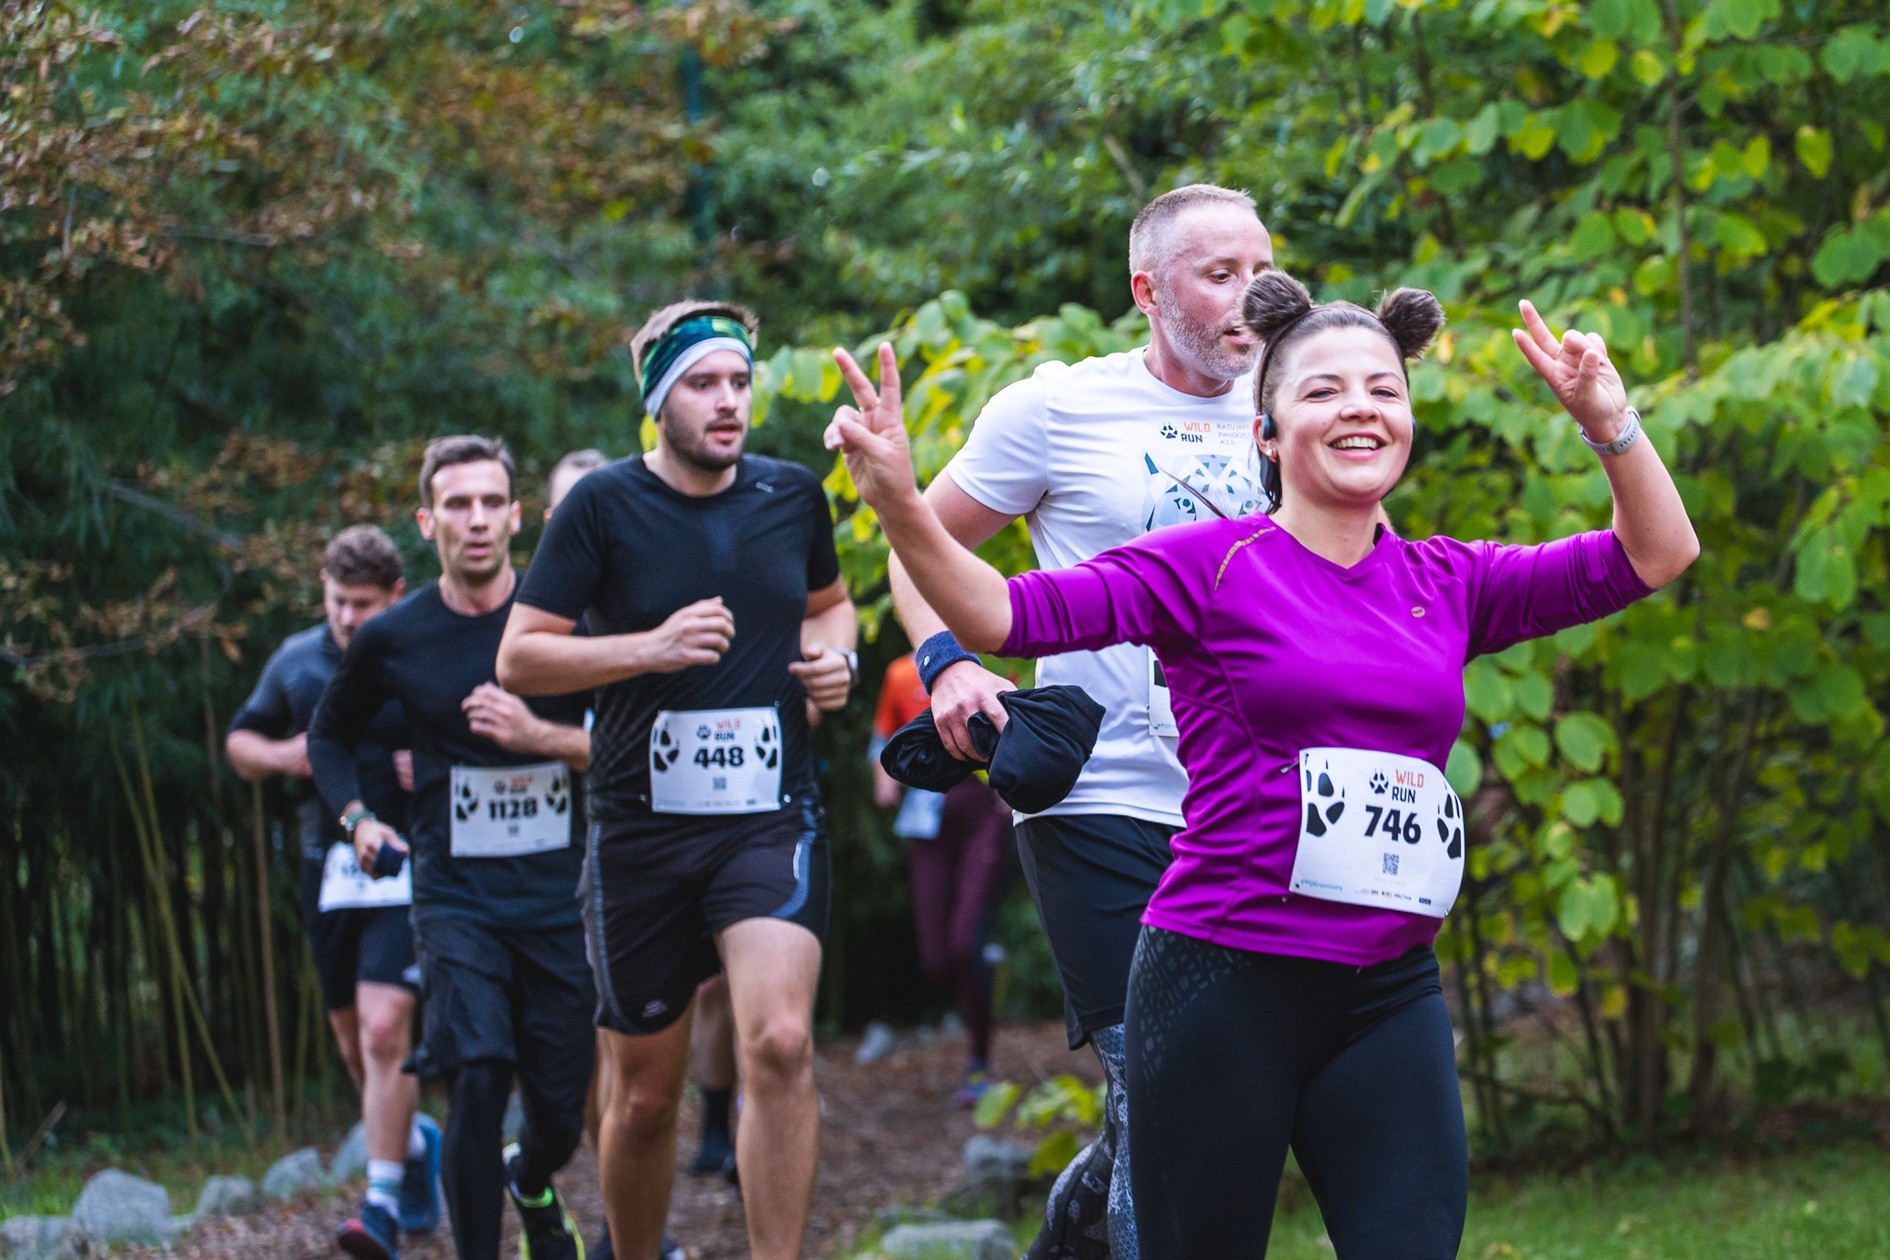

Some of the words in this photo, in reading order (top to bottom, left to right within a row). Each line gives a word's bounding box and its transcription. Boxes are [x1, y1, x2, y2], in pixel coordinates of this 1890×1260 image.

[1180, 433, 1203, 443] RUN
[1183, 422, 1211, 433] WILD
[693, 746, 745, 769] 448
[1395, 768, 1425, 789] WILD
[1391, 786, 1416, 804] RUN
[489, 796, 538, 820] 1128
[1363, 804, 1422, 845] 746
